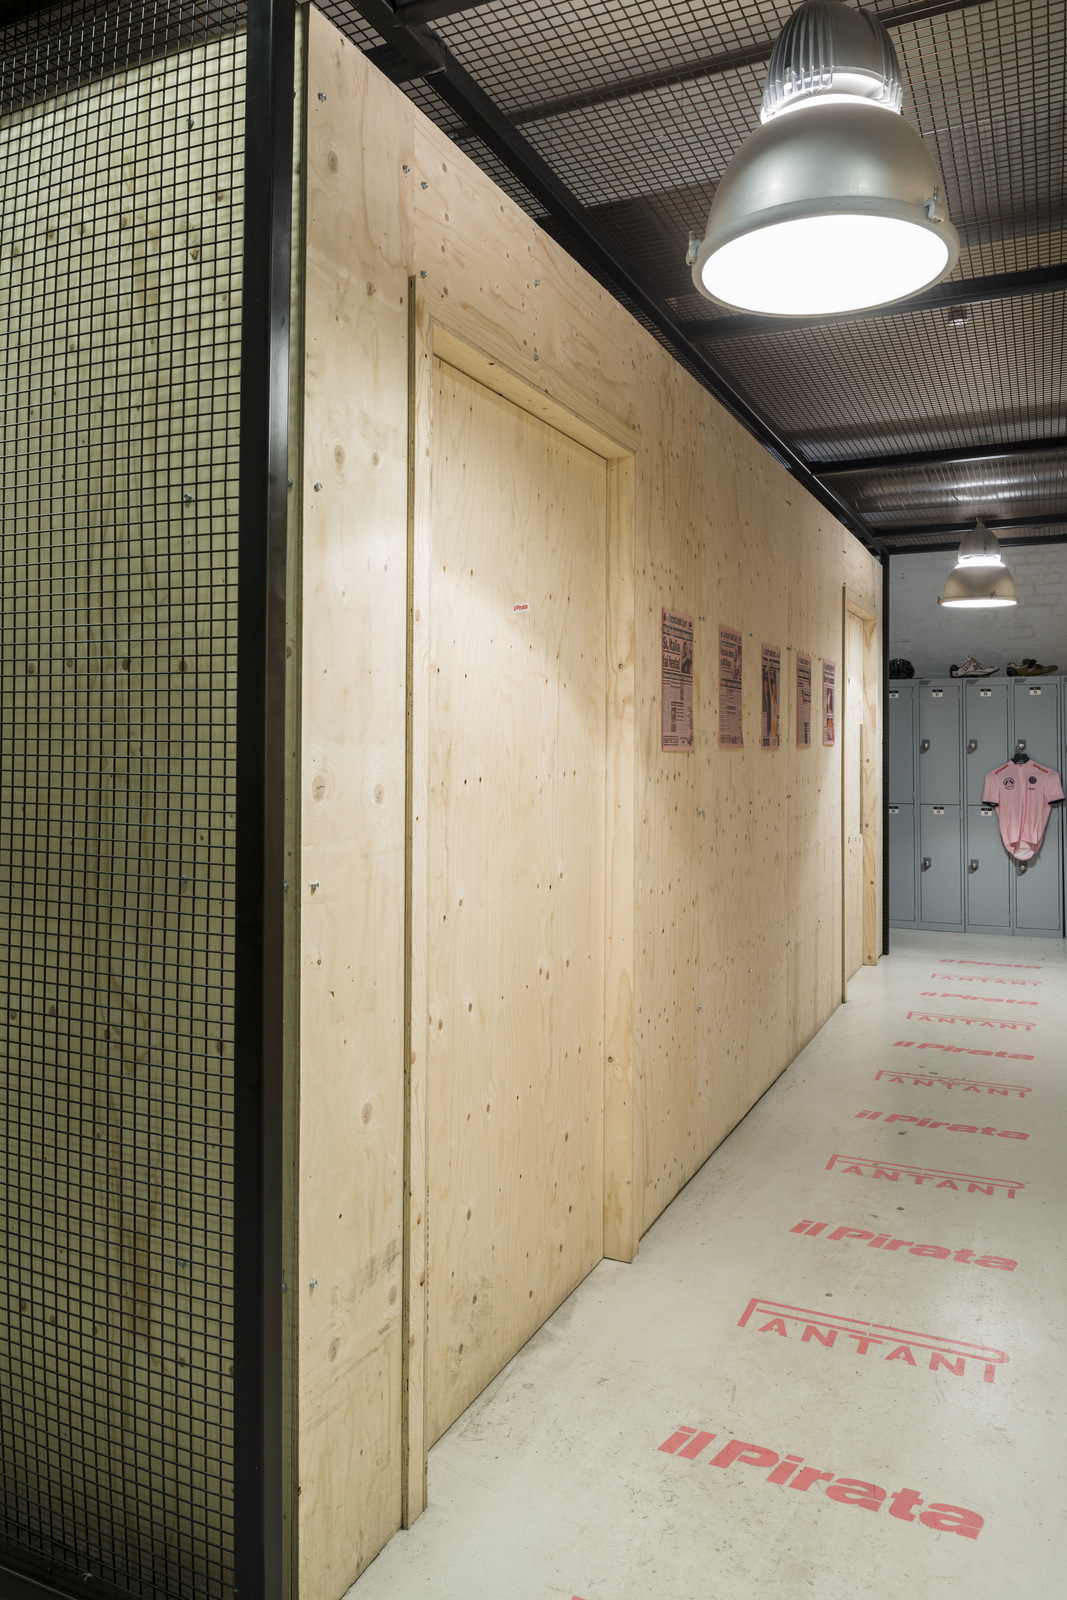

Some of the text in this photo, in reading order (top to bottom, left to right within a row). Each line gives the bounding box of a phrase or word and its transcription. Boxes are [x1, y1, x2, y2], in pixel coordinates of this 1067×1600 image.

[916, 1042, 1035, 1061] Pirata
[883, 1113, 1030, 1141] Pirata
[826, 1226, 1019, 1272] Pirata
[656, 1424, 985, 1541] il Pirata
